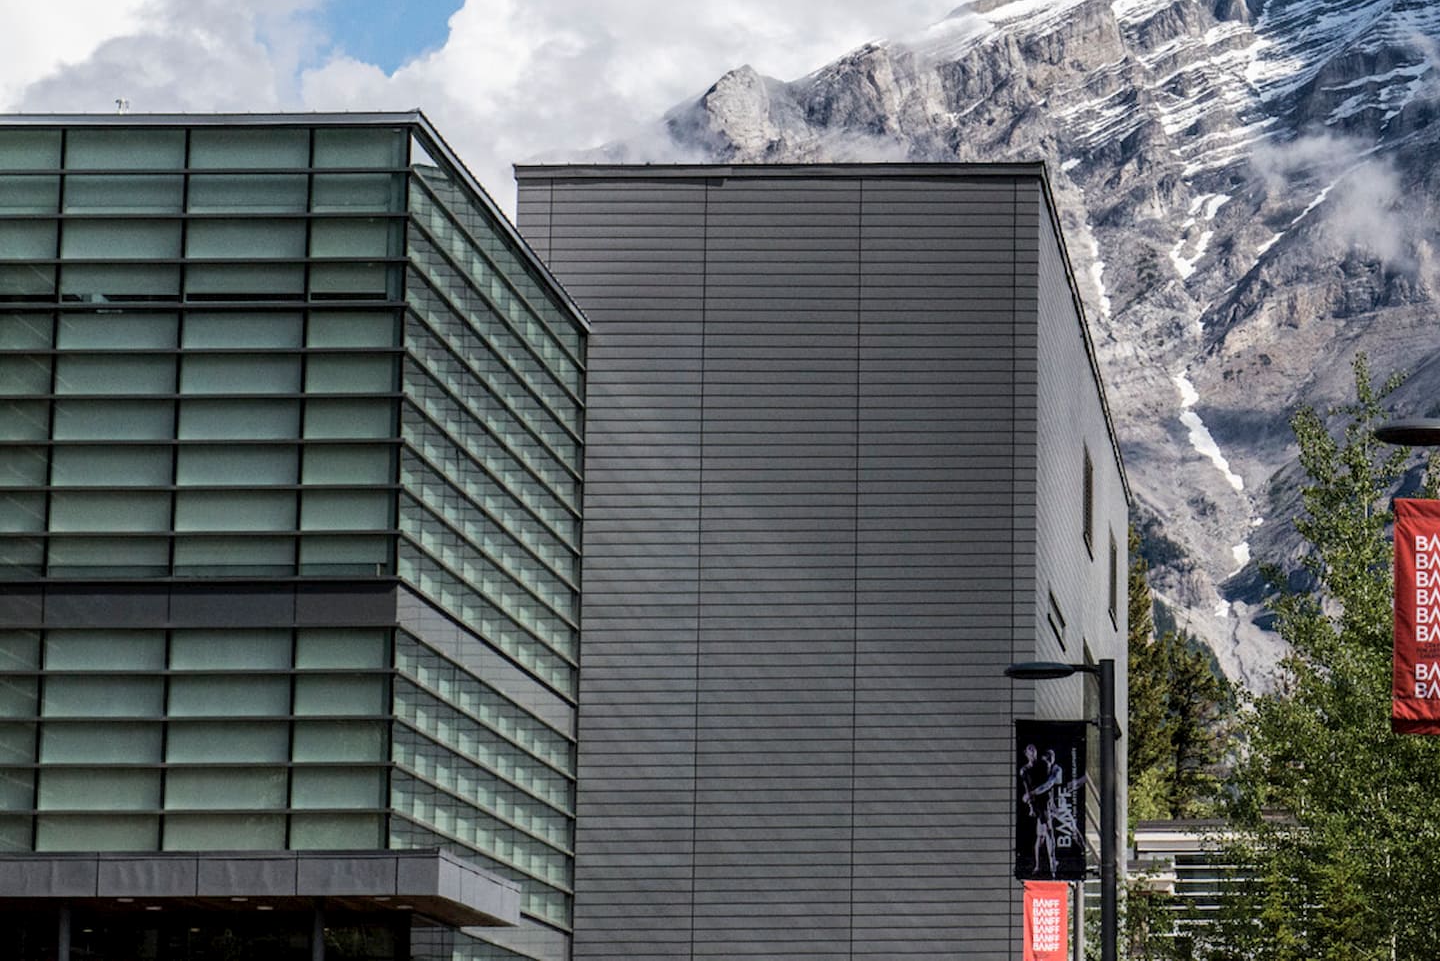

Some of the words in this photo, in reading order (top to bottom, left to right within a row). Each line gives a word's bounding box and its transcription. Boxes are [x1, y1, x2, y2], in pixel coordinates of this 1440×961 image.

[1032, 898, 1060, 908] BANFF
[1032, 907, 1060, 917] BANFF
[1032, 916, 1060, 925] BANFF
[1032, 925, 1060, 934] BANFF
[1032, 933, 1060, 943] BANFF
[1032, 942, 1060, 951] BANFF
